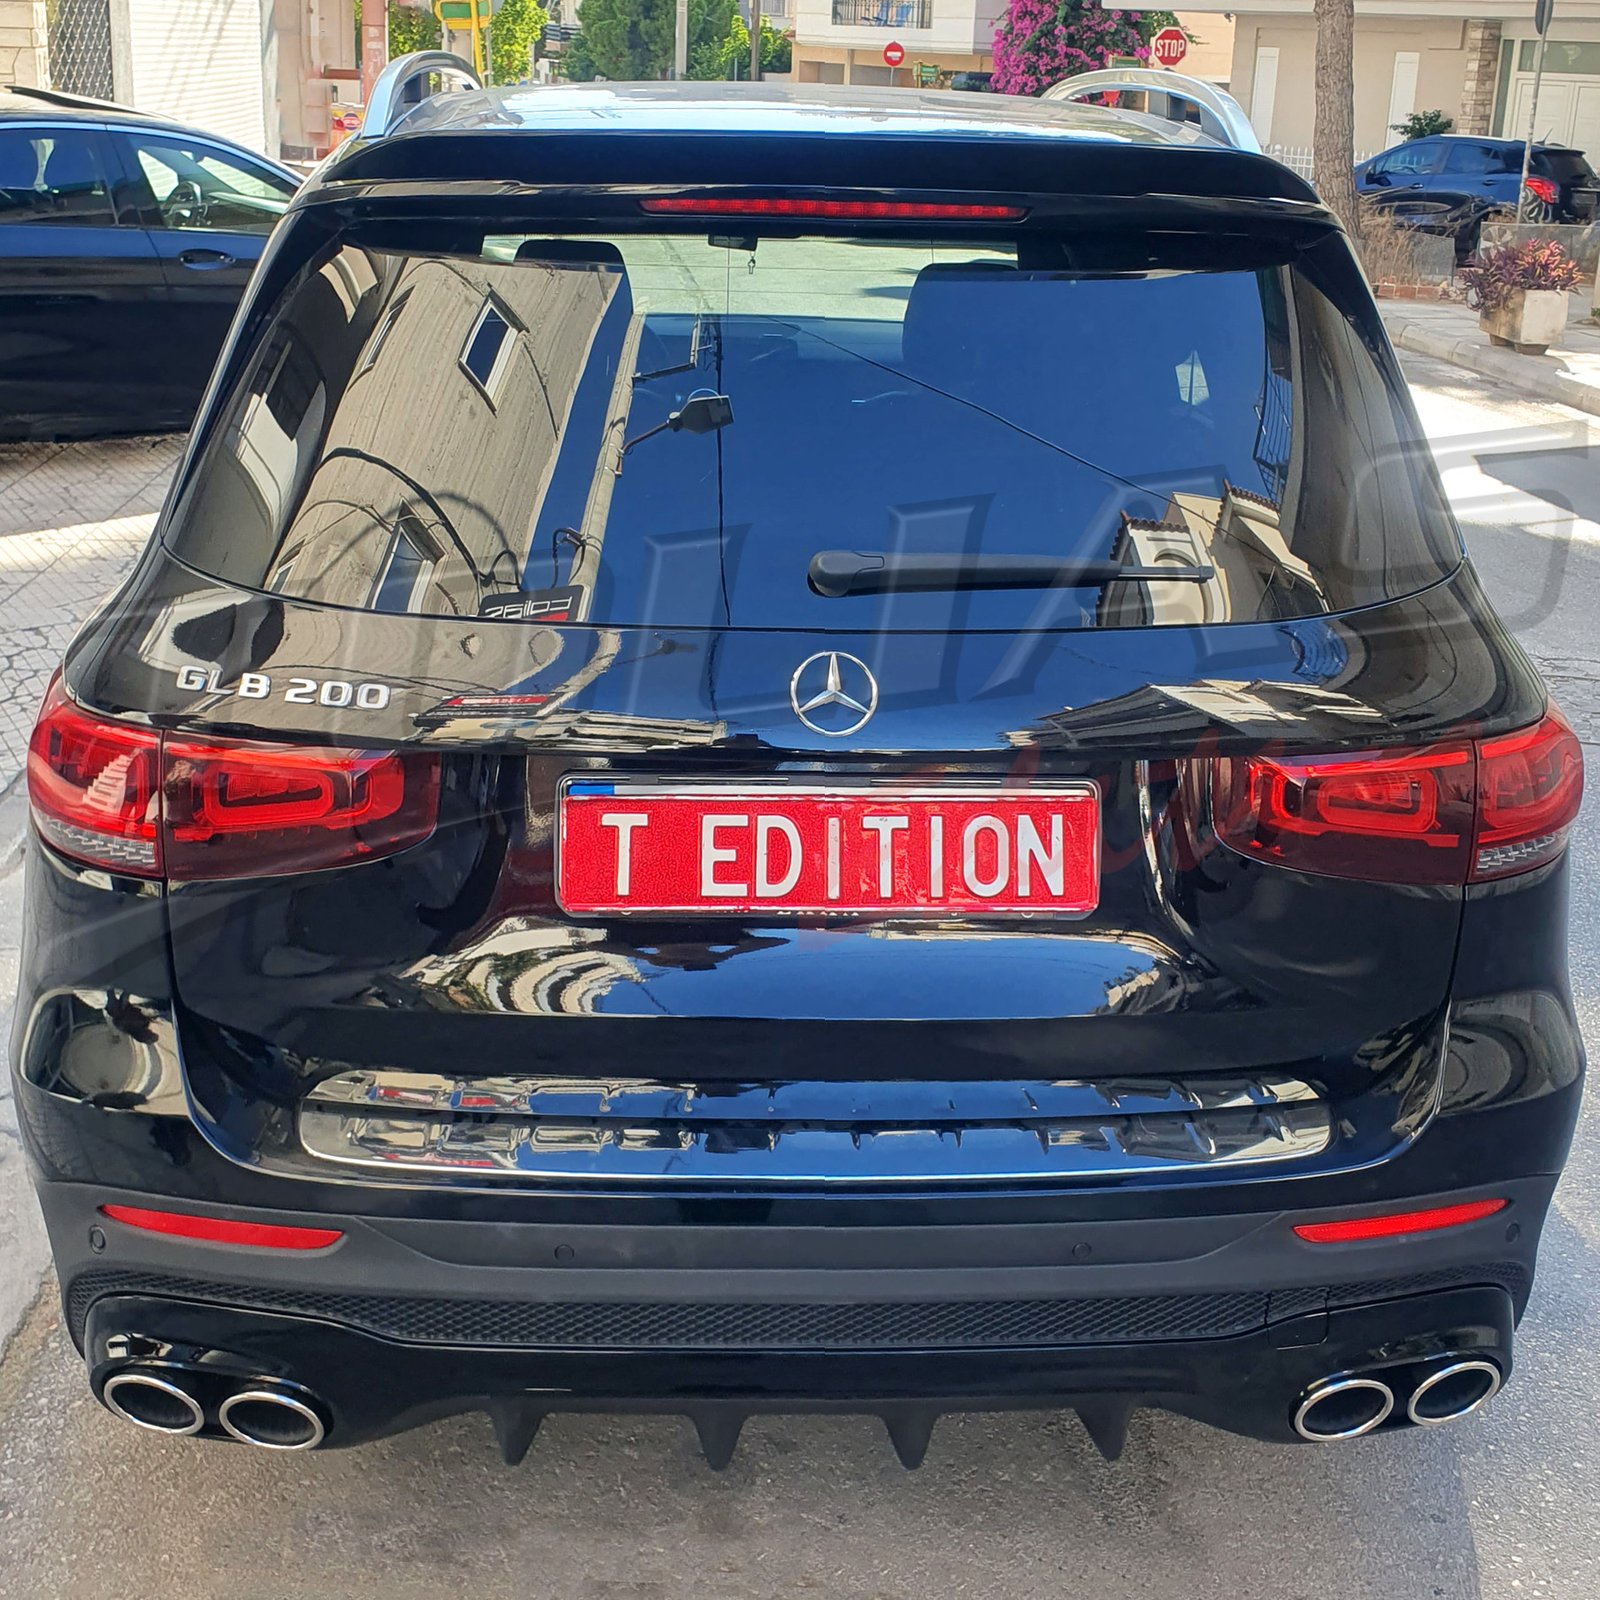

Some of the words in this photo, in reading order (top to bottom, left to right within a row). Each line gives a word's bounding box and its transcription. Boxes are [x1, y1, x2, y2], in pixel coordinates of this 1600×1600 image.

[1154, 37, 1185, 58] STOP
[175, 664, 272, 700] GLB
[284, 677, 391, 710] 200
[600, 813, 649, 896] T
[701, 813, 1064, 897] EDITION
